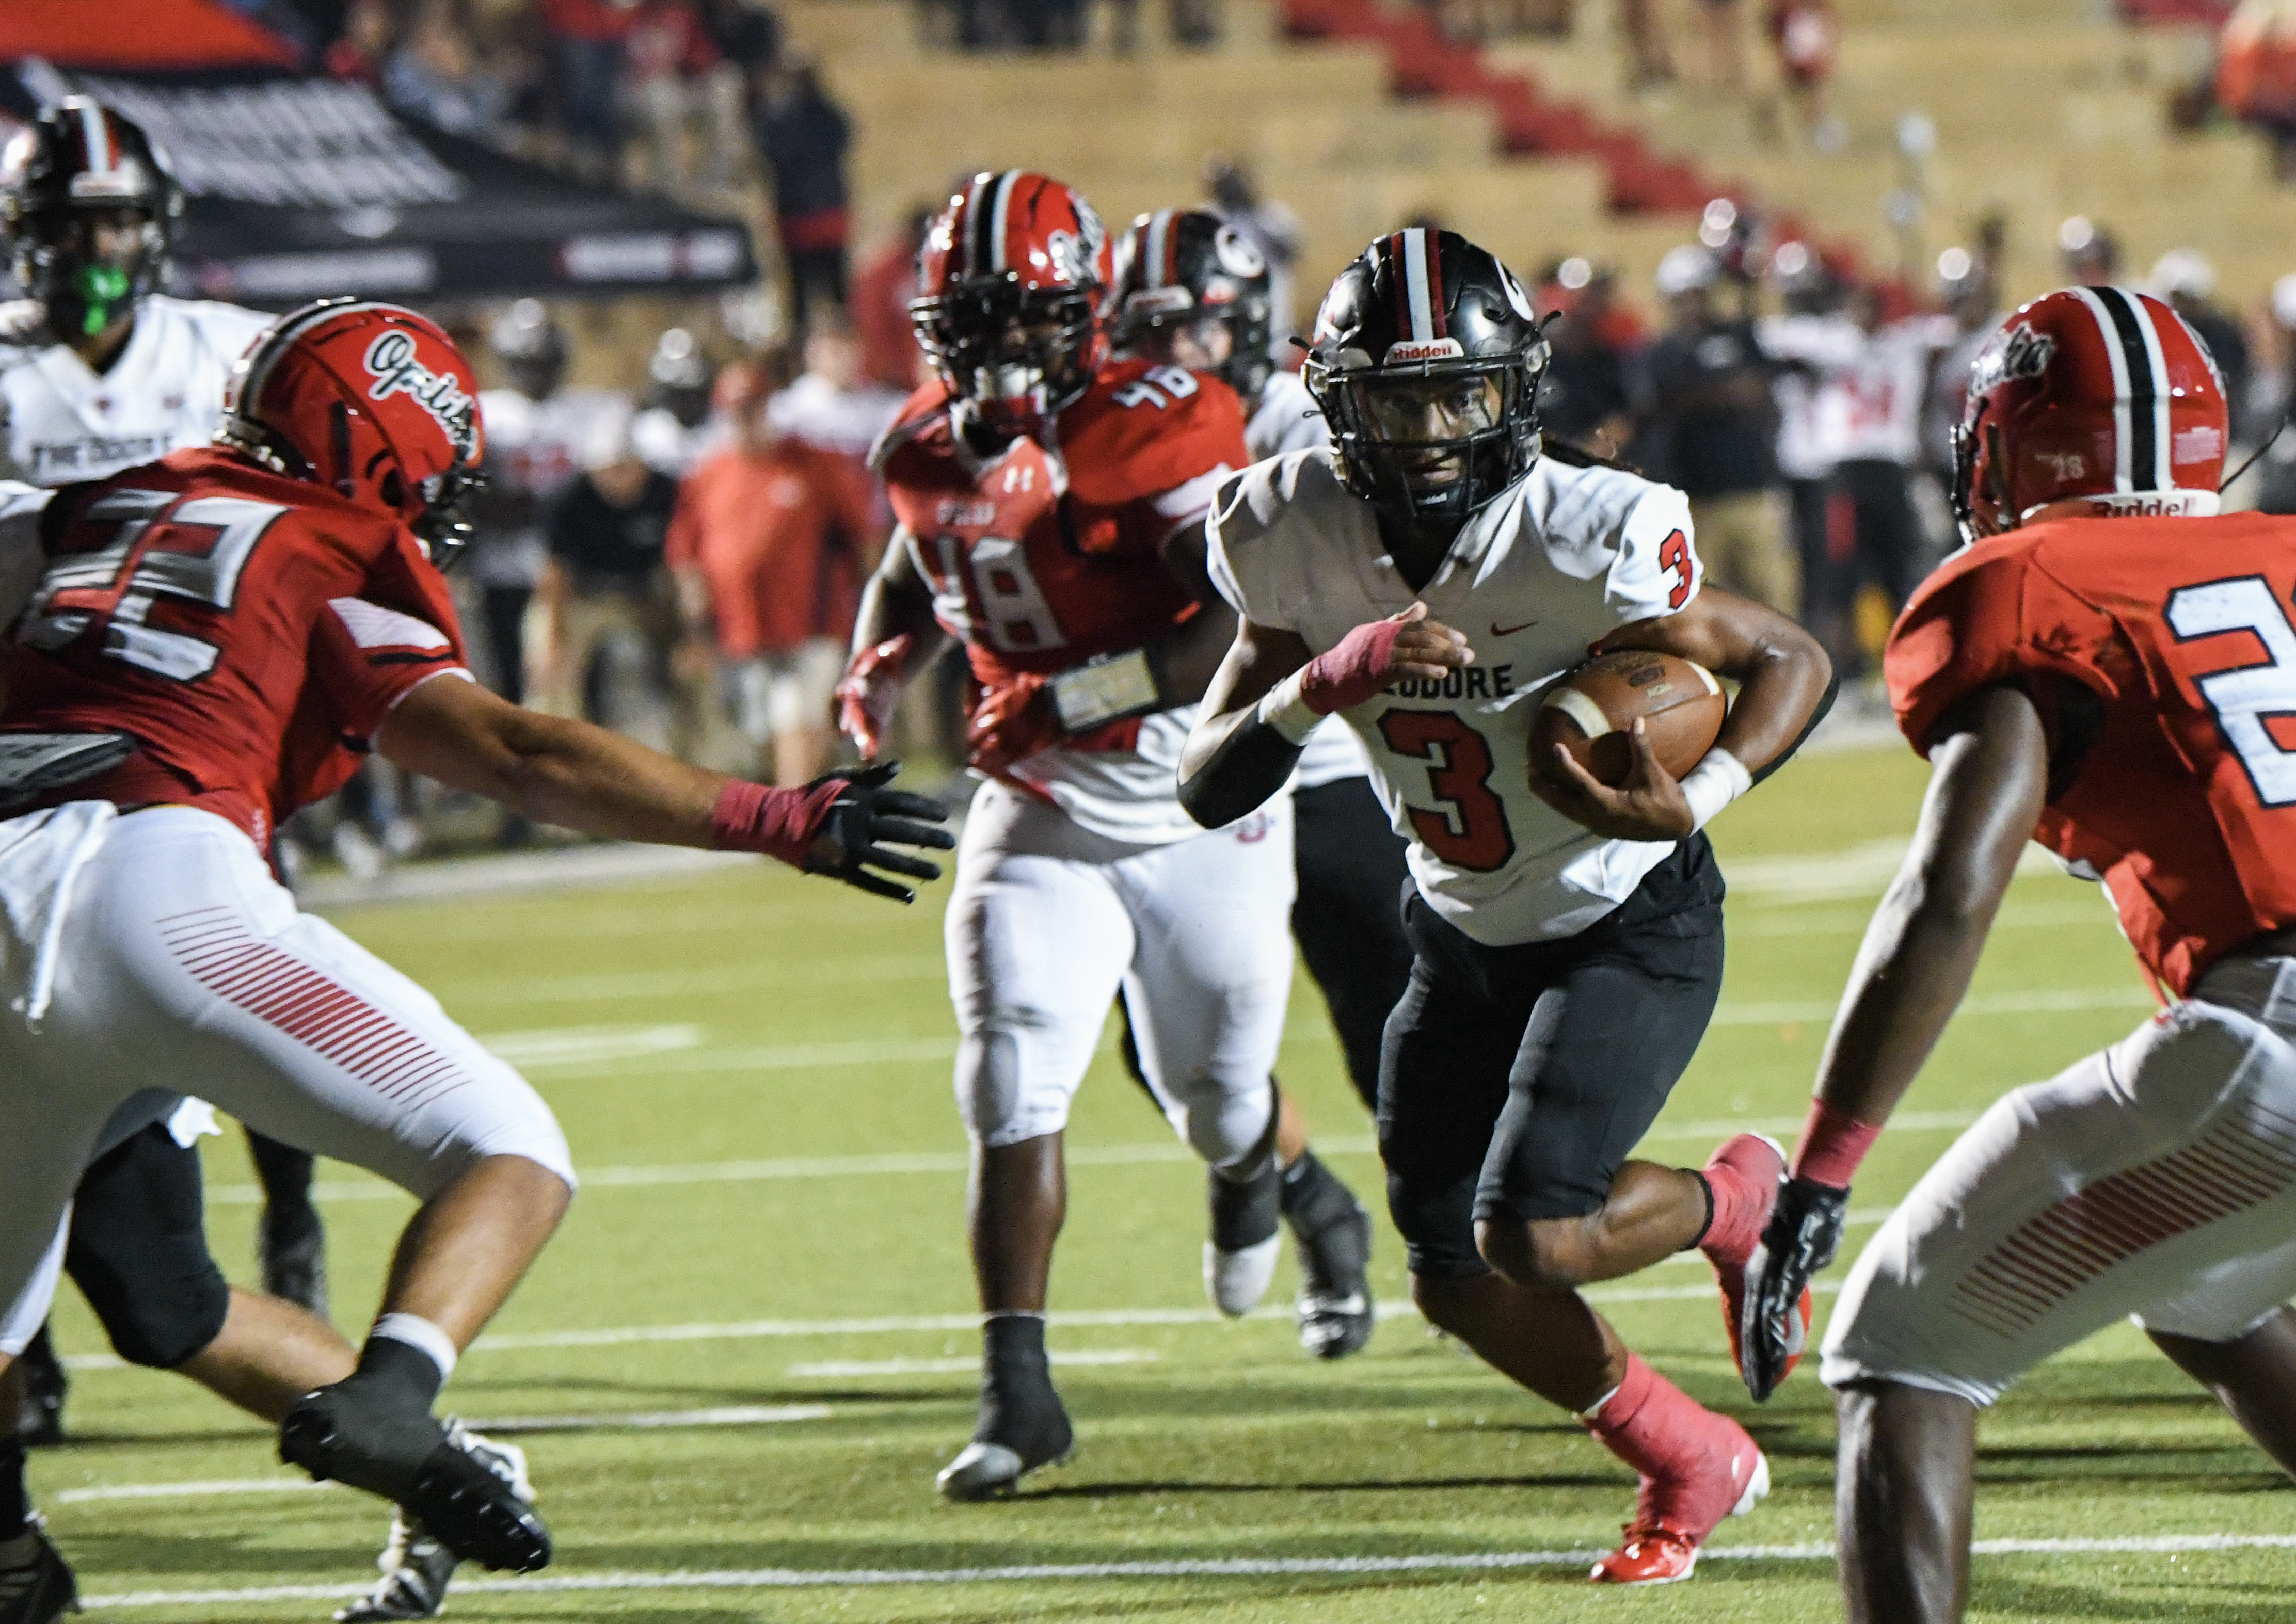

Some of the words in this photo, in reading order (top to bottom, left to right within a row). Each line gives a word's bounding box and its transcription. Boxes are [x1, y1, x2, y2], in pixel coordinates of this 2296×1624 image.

[1659, 528, 1693, 609] 3
[1384, 663, 1514, 699] ODORE
[2162, 574, 2296, 808] 2
[1377, 707, 1516, 873] 3
